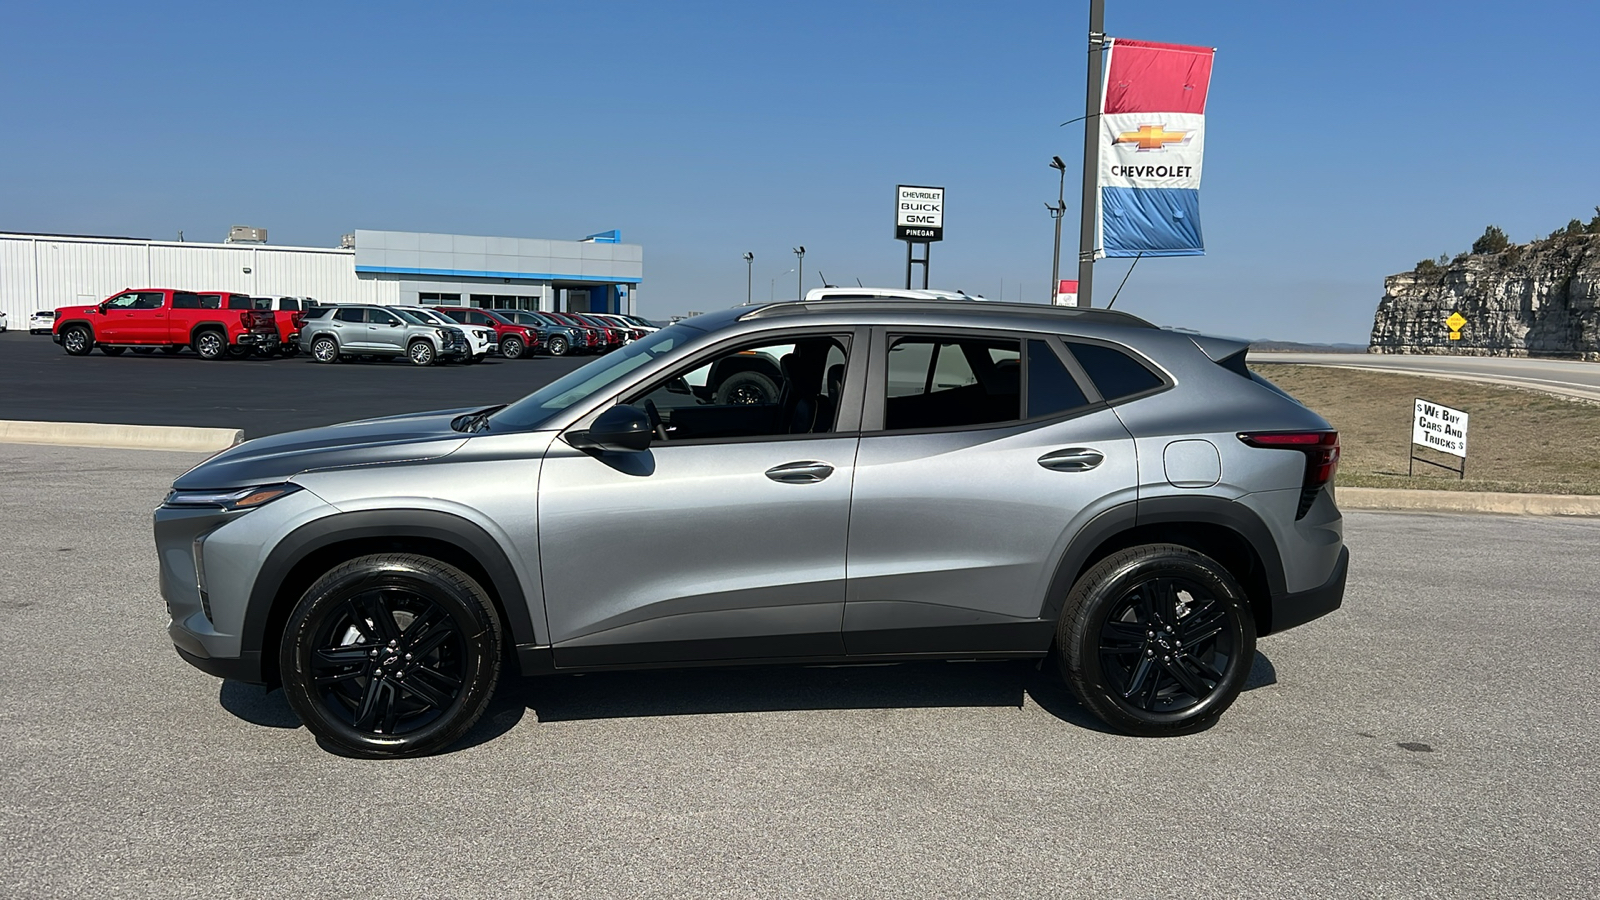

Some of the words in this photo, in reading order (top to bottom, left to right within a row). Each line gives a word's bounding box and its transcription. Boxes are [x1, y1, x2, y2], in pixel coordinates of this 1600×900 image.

[1111, 165, 1192, 178] CHEVROLET
[902, 191, 940, 200] CHEVROLET
[901, 202, 940, 212] BUICK
[906, 215, 935, 224] GMC
[906, 229, 934, 237] PINEGAR
[1424, 404, 1440, 418] WE
[1442, 410, 1460, 424] BUY
[1419, 416, 1442, 432] CARS
[1444, 424, 1462, 438] AND
[1424, 430, 1456, 450] TRUCKS
